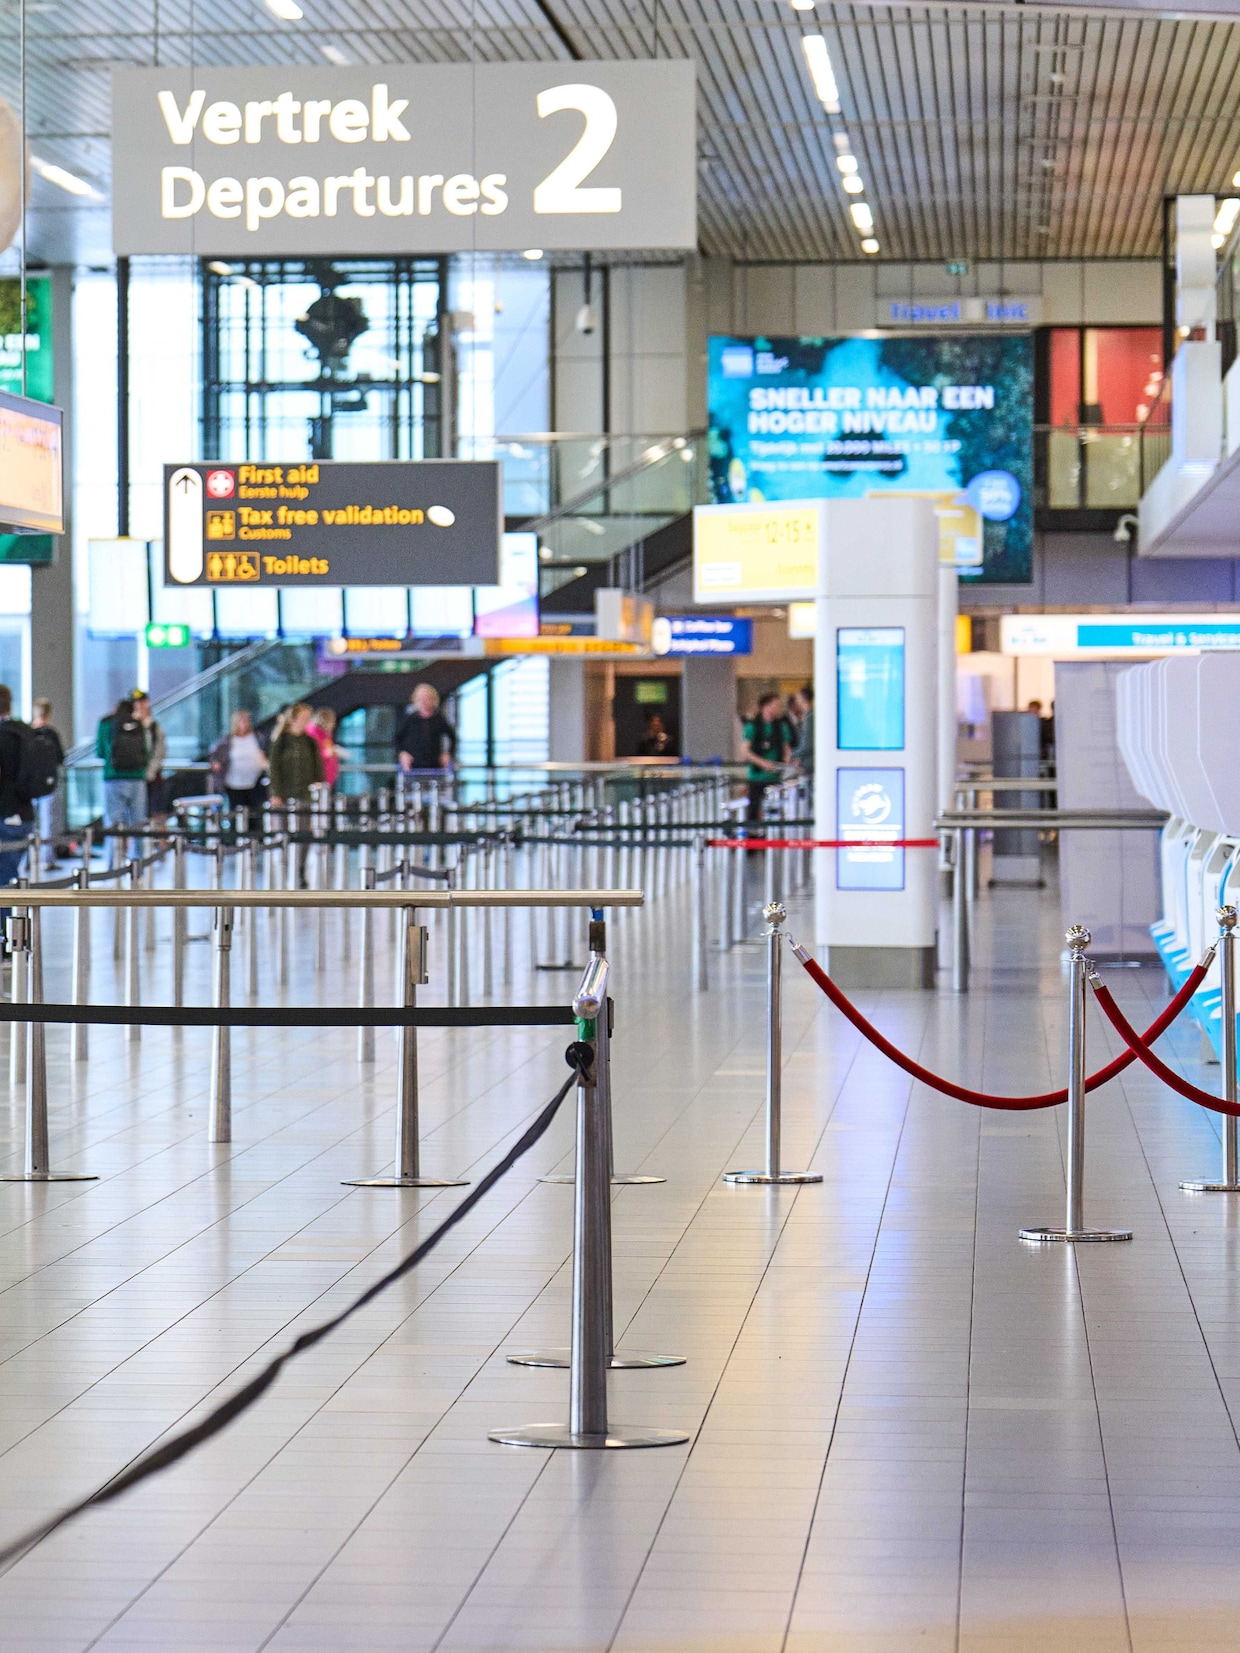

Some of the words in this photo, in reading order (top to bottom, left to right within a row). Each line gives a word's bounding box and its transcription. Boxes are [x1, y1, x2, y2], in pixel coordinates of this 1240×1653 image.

[158, 83, 411, 144] Vertrek
[161, 167, 508, 232] Departures
[534, 83, 622, 214] 2
[890, 302, 959, 320] Travel
[749, 388, 861, 411] SNELLER
[866, 387, 938, 410] NAAR
[943, 386, 995, 409] EEN
[749, 411, 838, 434] HOGER
[843, 410, 937, 433] NIVEAU
[238, 465, 283, 484] First
[289, 464, 319, 484] aid
[238, 486, 278, 499] Eerste
[280, 485, 309, 500] hulp
[238, 507, 273, 525] Tax
[277, 505, 319, 525] free
[322, 505, 424, 526] validation
[238, 527, 291, 541] Customs
[765, 520, 800, 544] 12-15
[263, 556, 329, 575] Toilets
[1132, 631, 1174, 646] Travel
